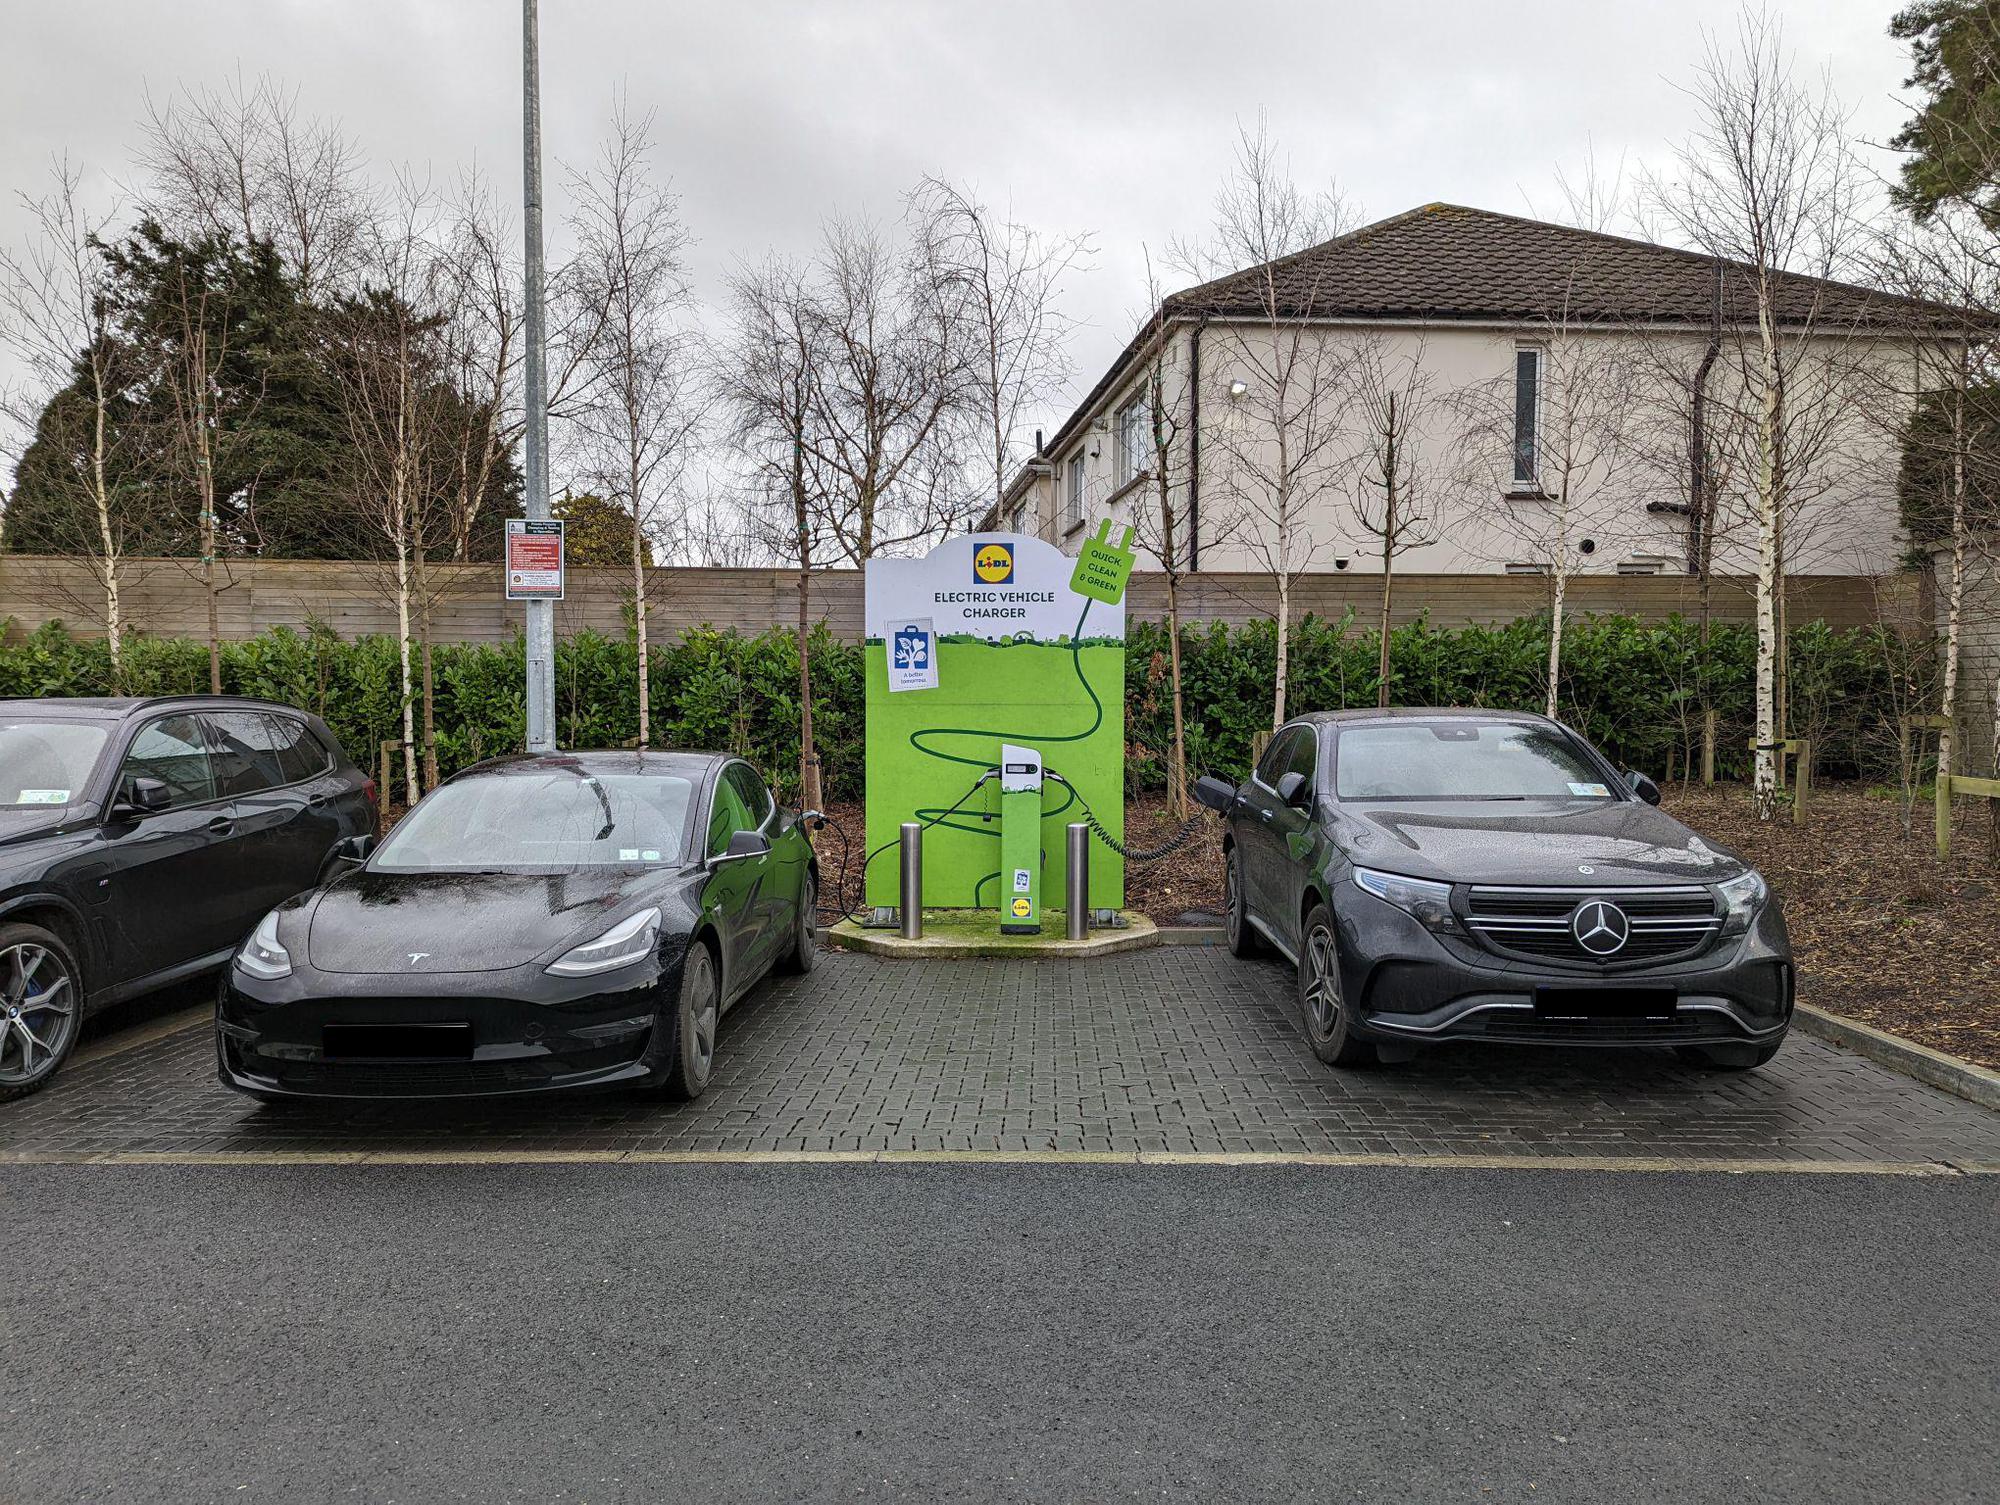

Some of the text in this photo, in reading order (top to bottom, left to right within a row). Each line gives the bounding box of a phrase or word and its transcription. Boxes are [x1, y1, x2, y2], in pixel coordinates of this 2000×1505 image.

[1091, 550, 1122, 567] QUICK,
[1088, 563, 1117, 578] CLEAN
[1087, 576, 1117, 592] GREEN
[934, 592, 1055, 603] ELECTRIC VEHICLE
[963, 608, 1026, 618] CHARGER
